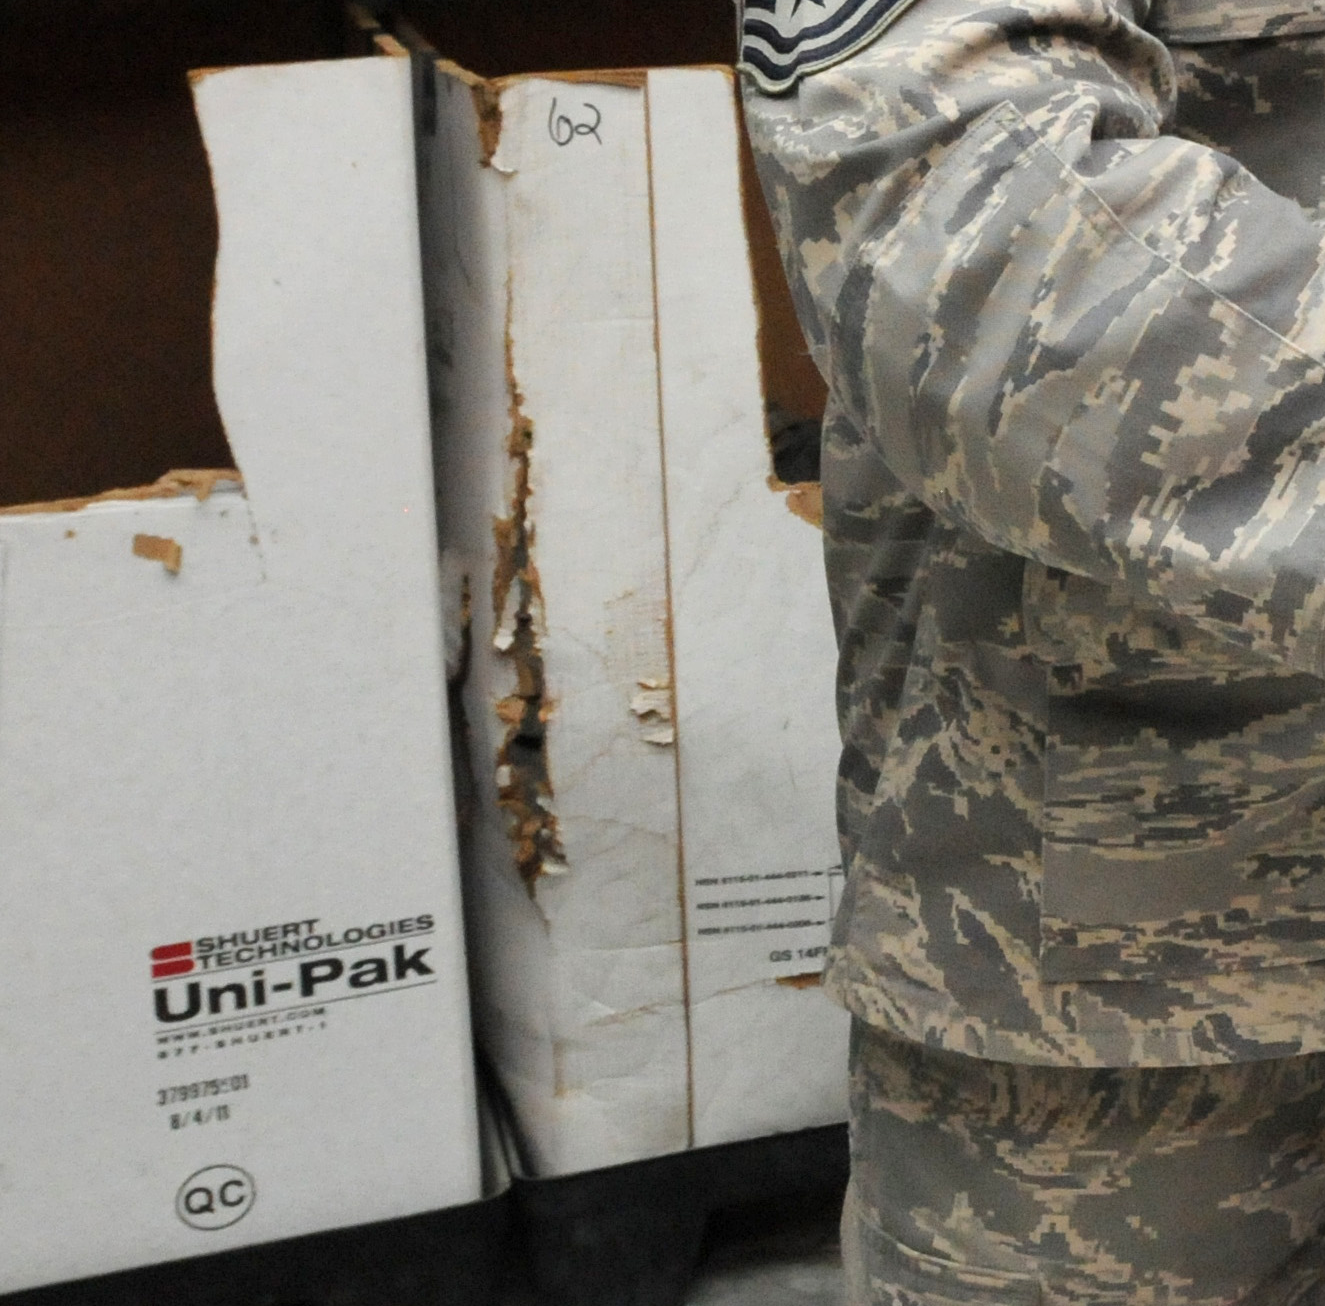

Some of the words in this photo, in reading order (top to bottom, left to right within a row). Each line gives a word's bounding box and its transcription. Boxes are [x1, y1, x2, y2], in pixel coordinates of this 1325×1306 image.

[547, 96, 603, 147] 62
[195, 918, 320, 953] SHUERT
[197, 914, 435, 970] TECHNOLOGIES
[153, 944, 435, 1024] Uni-Pak
[184, 1179, 244, 1214] QC
